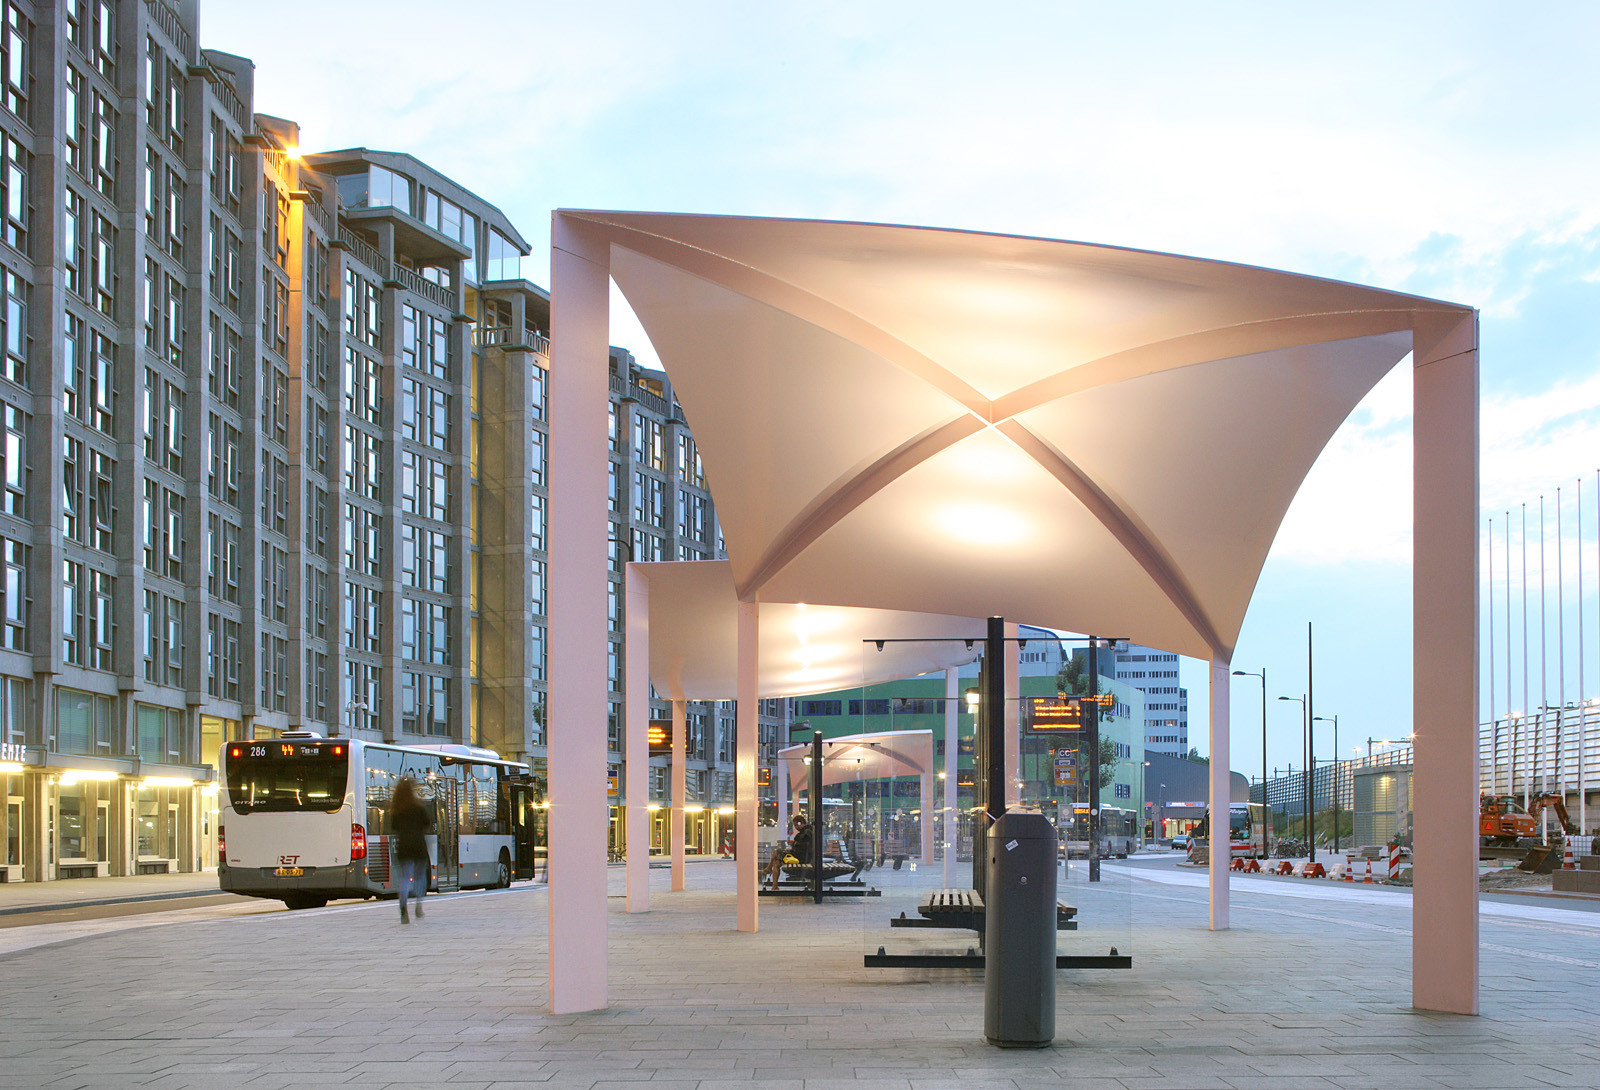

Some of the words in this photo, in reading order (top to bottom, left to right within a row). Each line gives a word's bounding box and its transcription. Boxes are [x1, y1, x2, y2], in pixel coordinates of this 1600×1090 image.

[250, 746, 266, 757] 286
[281, 744, 294, 756] 44
[277, 855, 300, 865] RET
